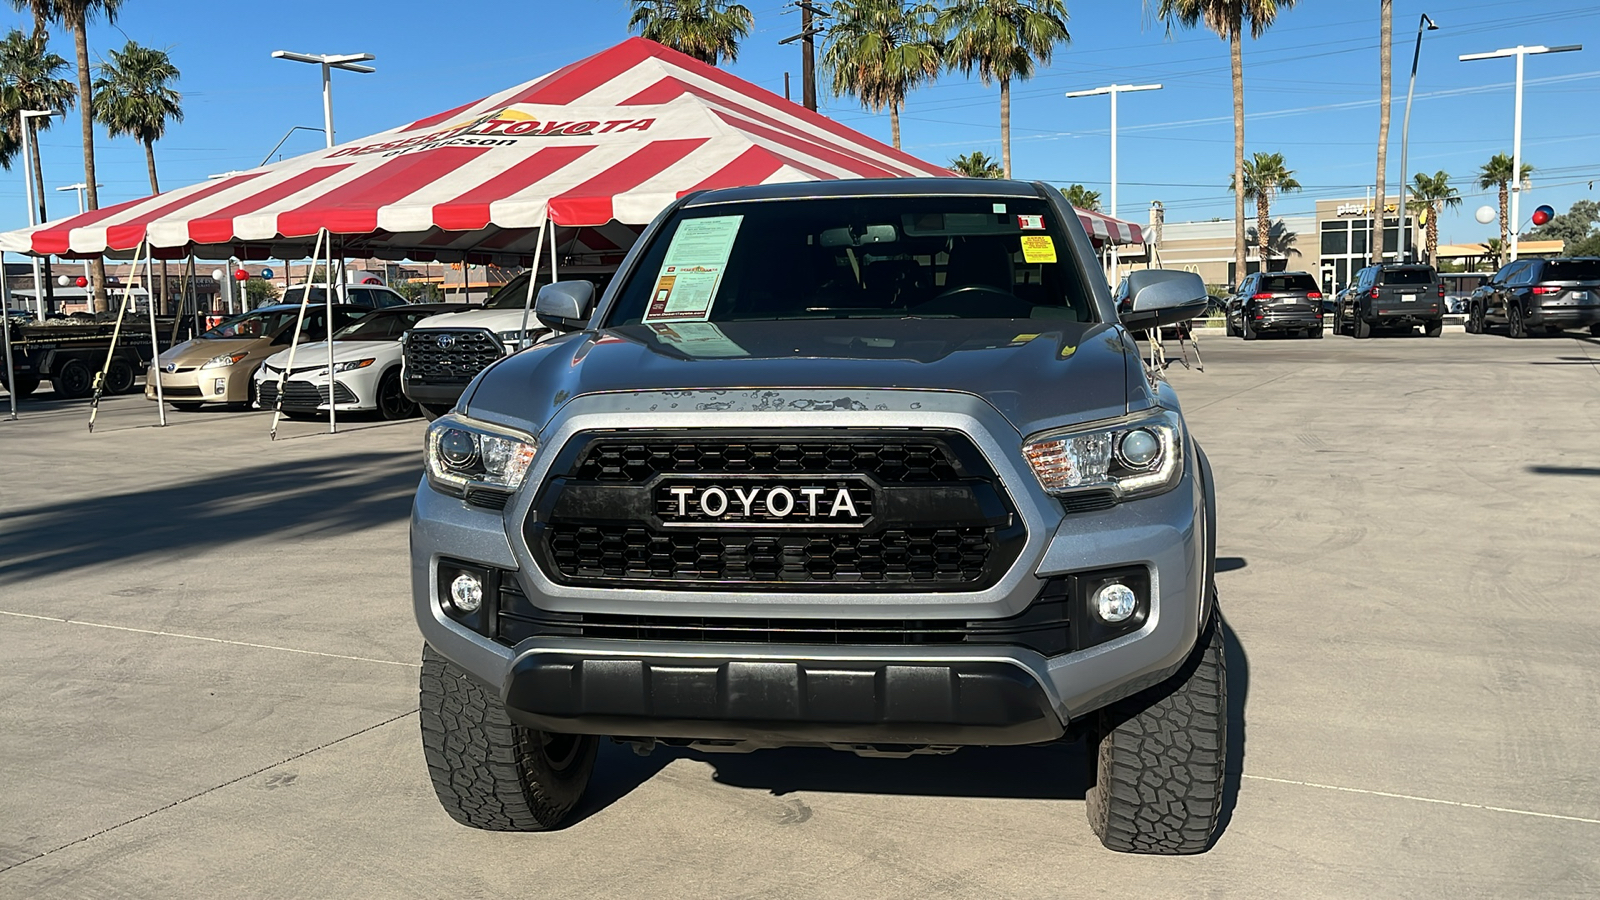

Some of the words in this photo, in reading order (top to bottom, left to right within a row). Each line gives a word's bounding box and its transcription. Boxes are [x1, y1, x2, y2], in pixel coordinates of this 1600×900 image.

[323, 124, 474, 159] DESERT
[479, 118, 657, 135] TOYOTA
[418, 138, 518, 151] Tucson
[669, 486, 859, 517] TOYOTA
